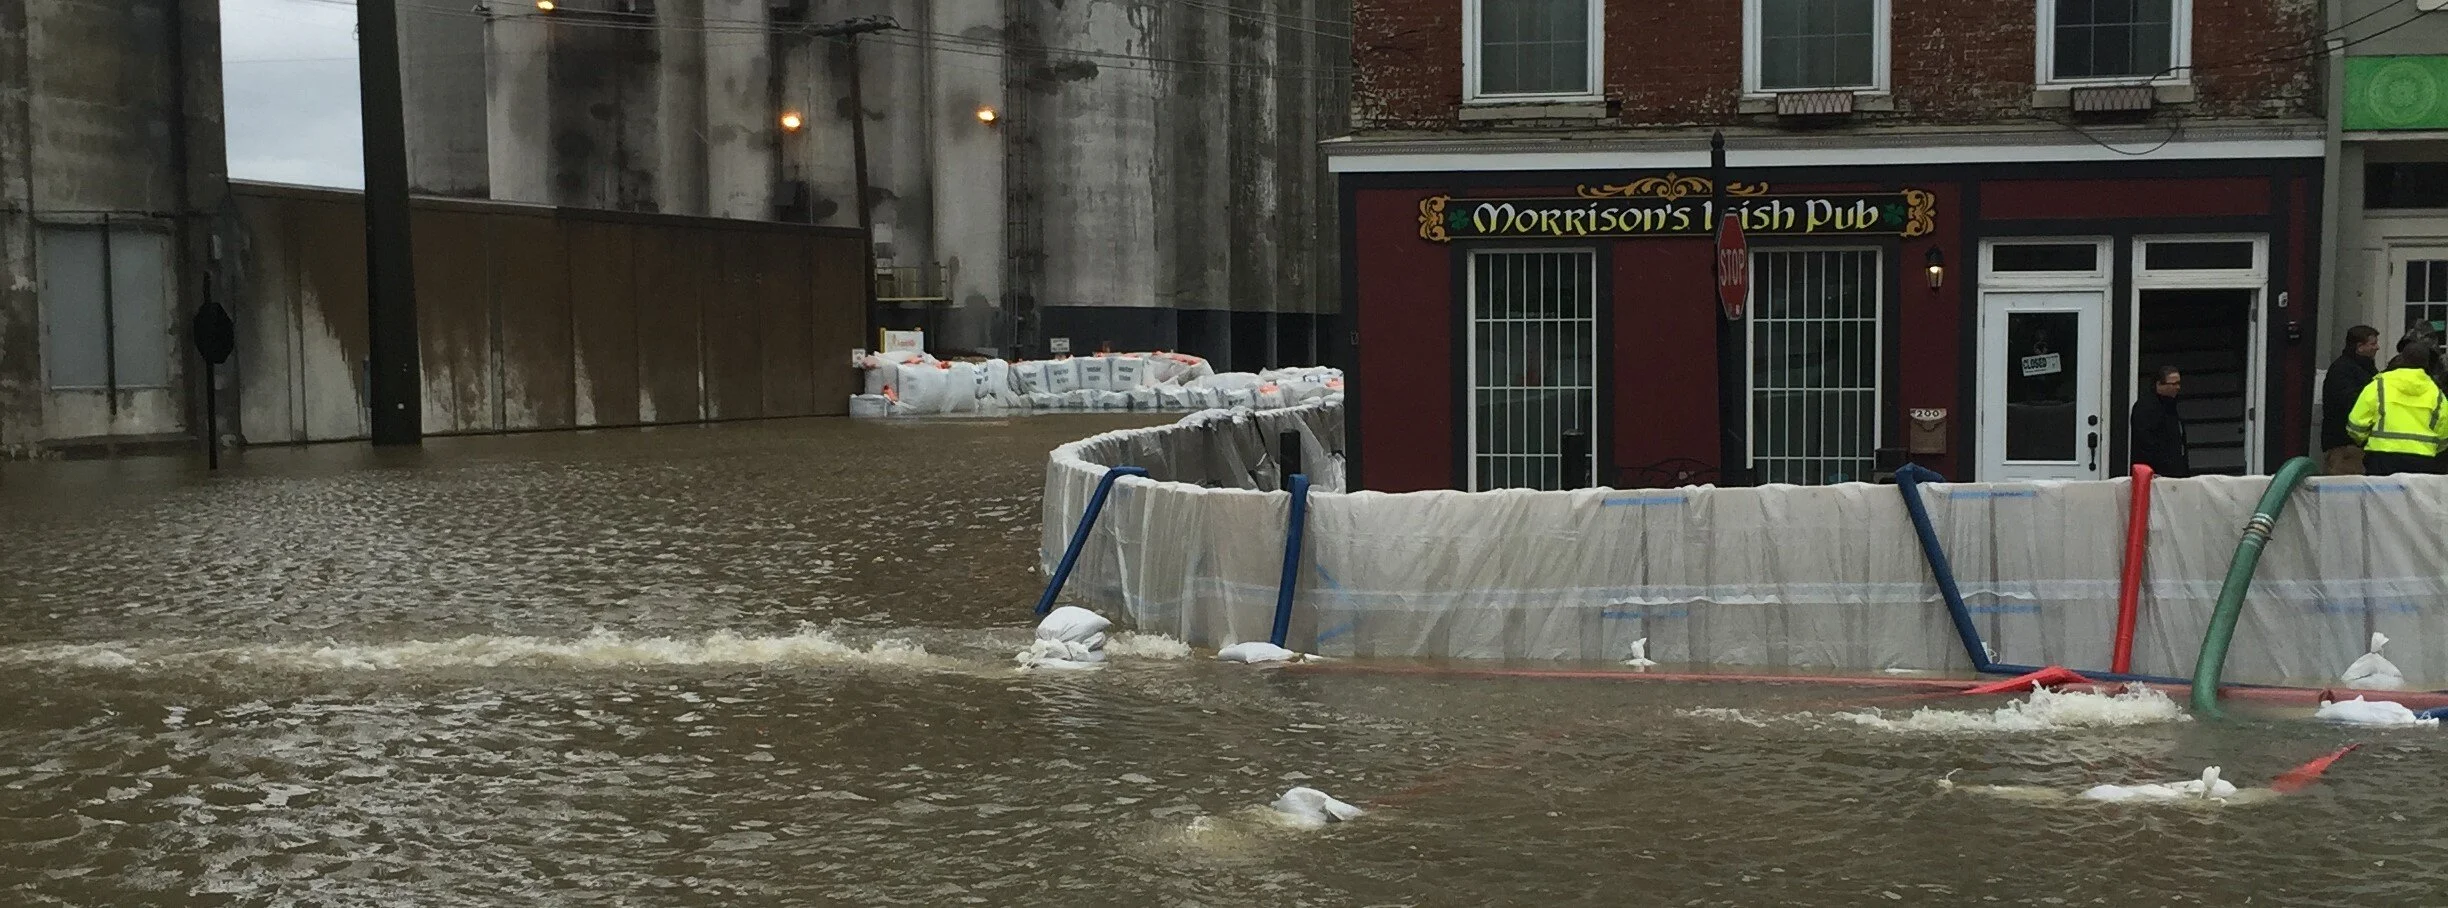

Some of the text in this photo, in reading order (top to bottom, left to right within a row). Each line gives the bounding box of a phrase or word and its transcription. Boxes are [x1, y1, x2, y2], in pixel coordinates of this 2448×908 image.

[1473, 198, 1879, 236] Morrison's Iish Pub
[1720, 248, 1745, 286] STOP
[2023, 357, 2048, 370] CLOSED
[1916, 409, 1940, 418] 200
